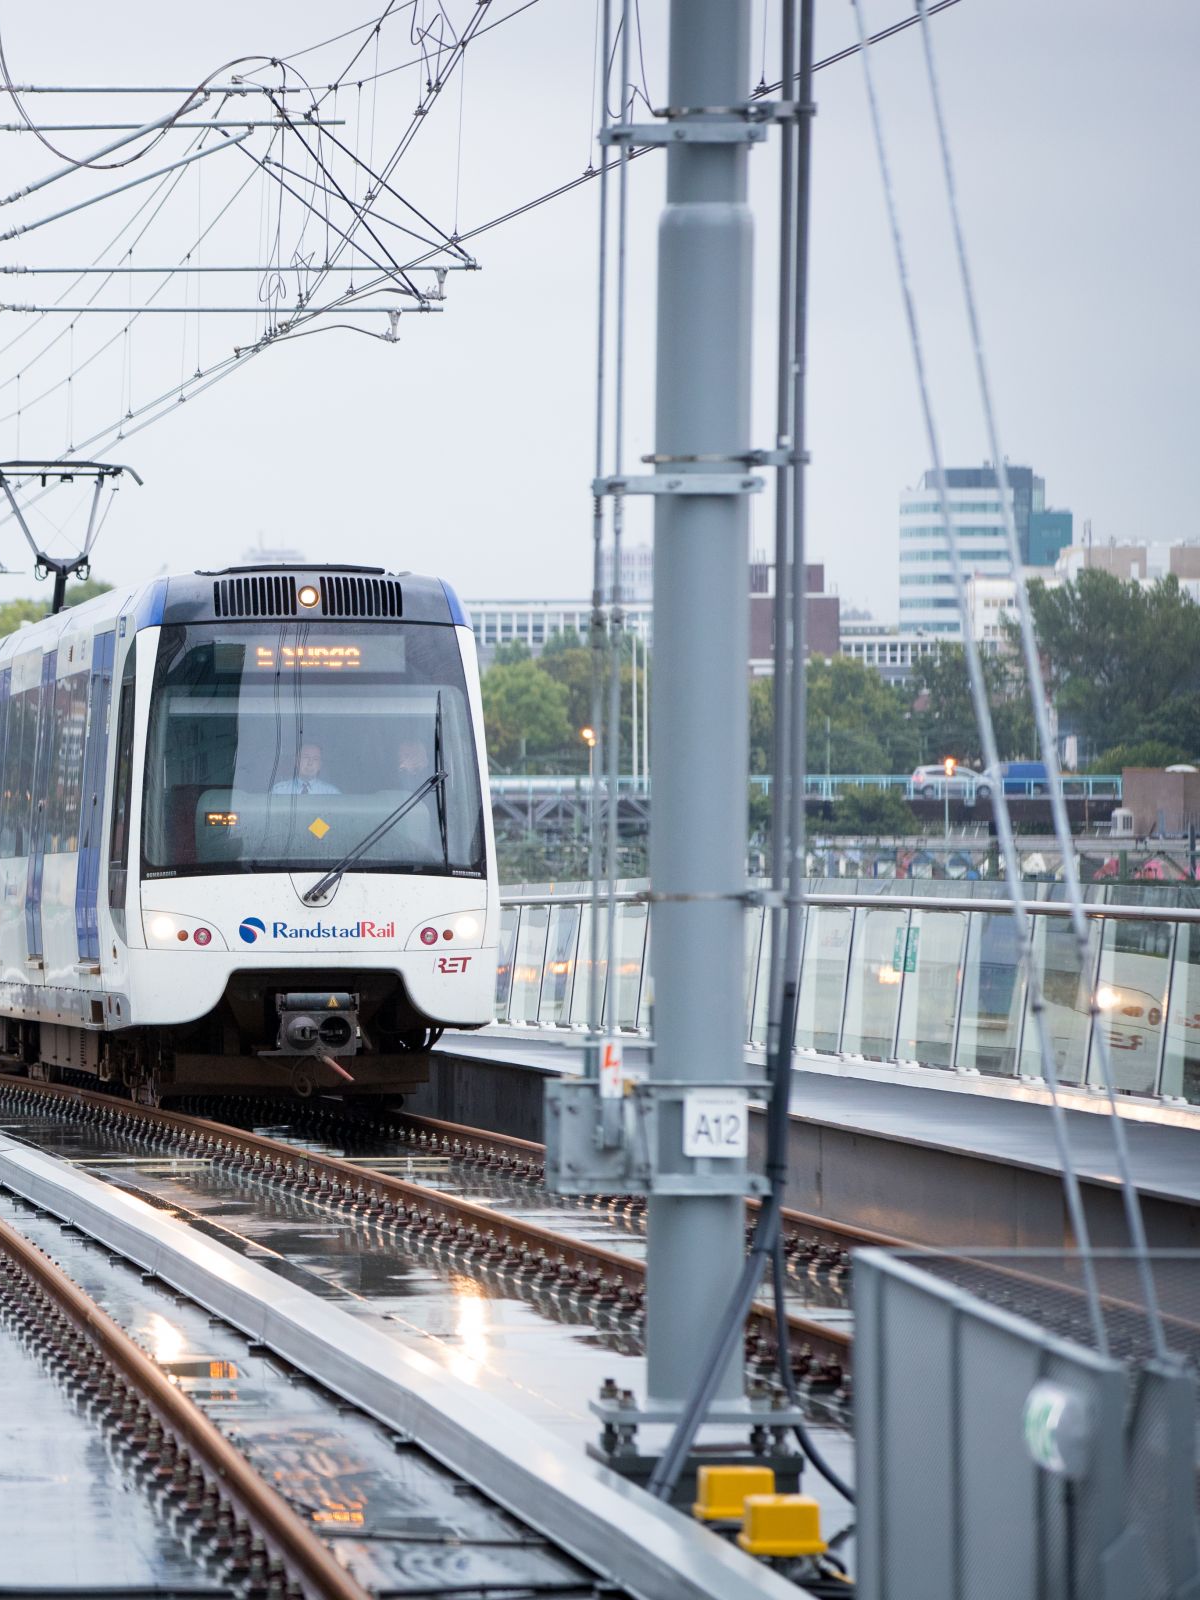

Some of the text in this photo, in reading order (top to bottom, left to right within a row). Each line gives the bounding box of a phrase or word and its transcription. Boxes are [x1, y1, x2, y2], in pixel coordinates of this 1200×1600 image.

[272, 921, 395, 938] RandstadRail
[437, 957, 472, 973] RET
[694, 1113, 741, 1145] A12
